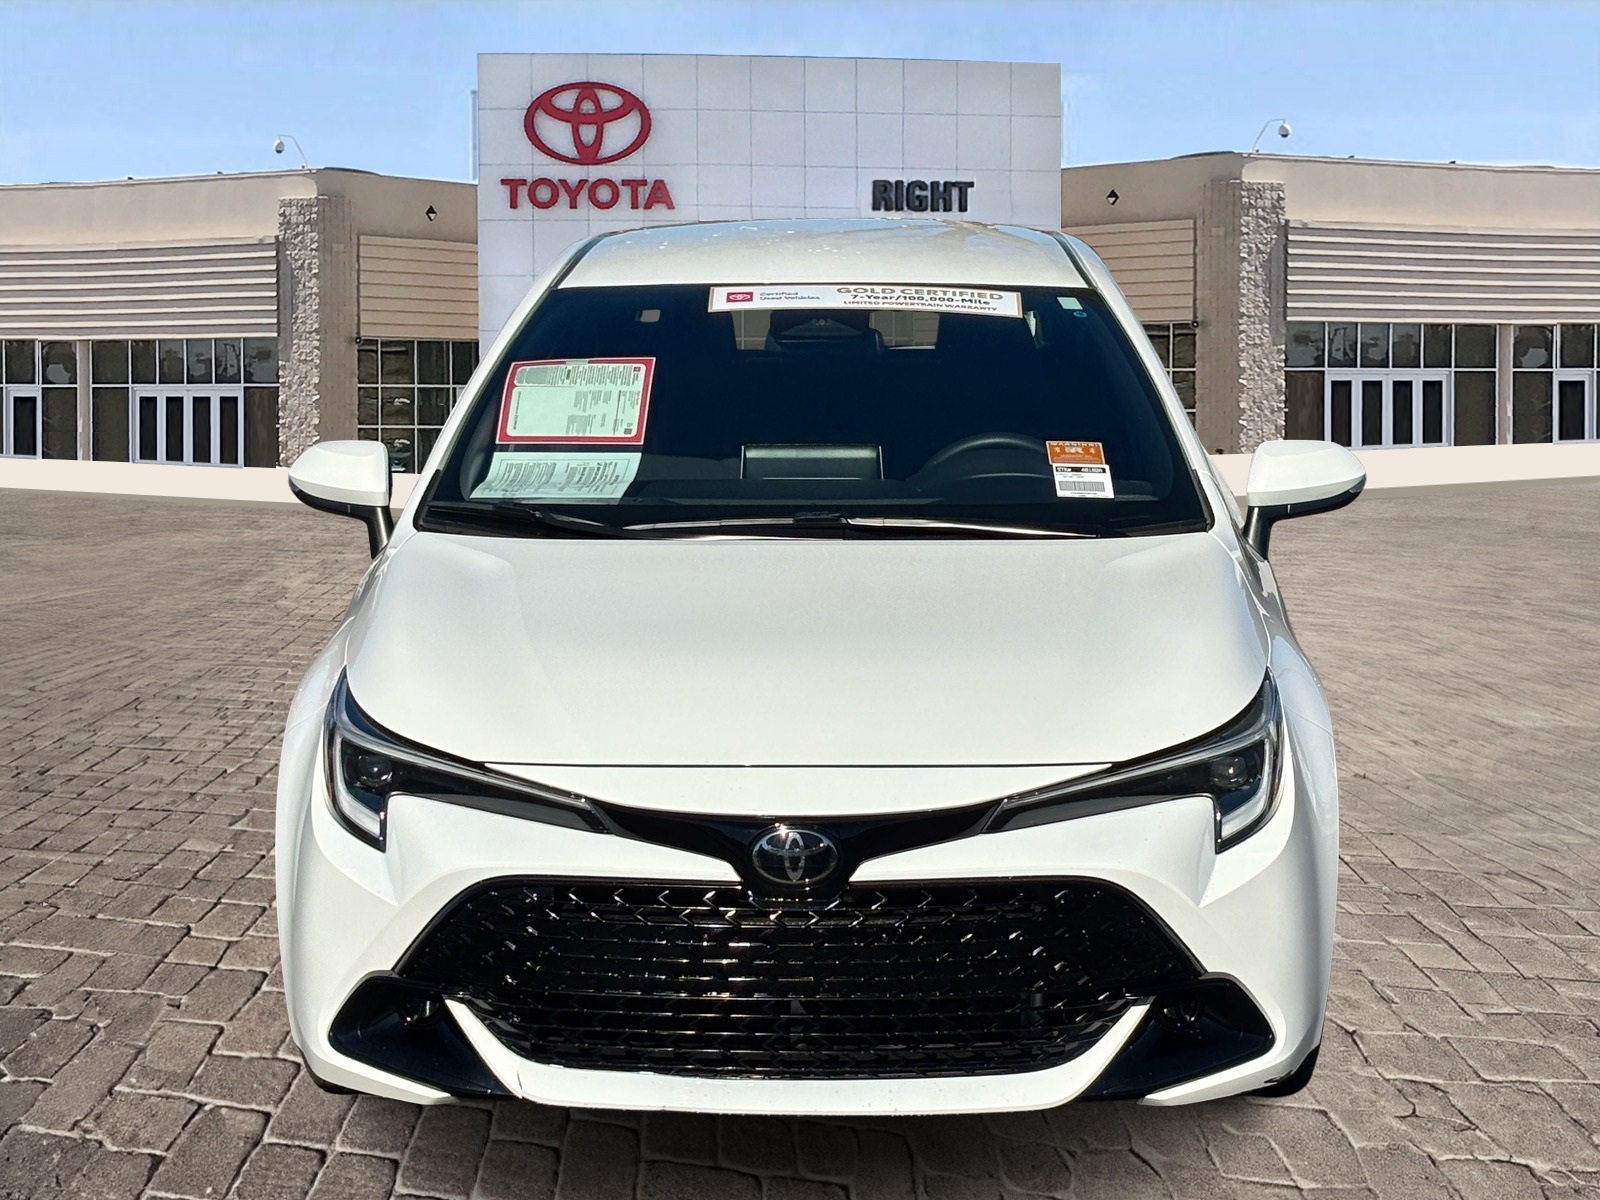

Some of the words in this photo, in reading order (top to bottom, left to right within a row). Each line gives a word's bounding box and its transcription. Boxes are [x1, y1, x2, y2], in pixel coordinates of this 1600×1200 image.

[500, 177, 675, 209] TOYOTA
[872, 179, 975, 212] RIGHT
[850, 294, 991, 305] 7-Year/100,000-Mile
[900, 288, 1003, 300] CERTIFIED
[945, 303, 998, 311] WARRANTY
